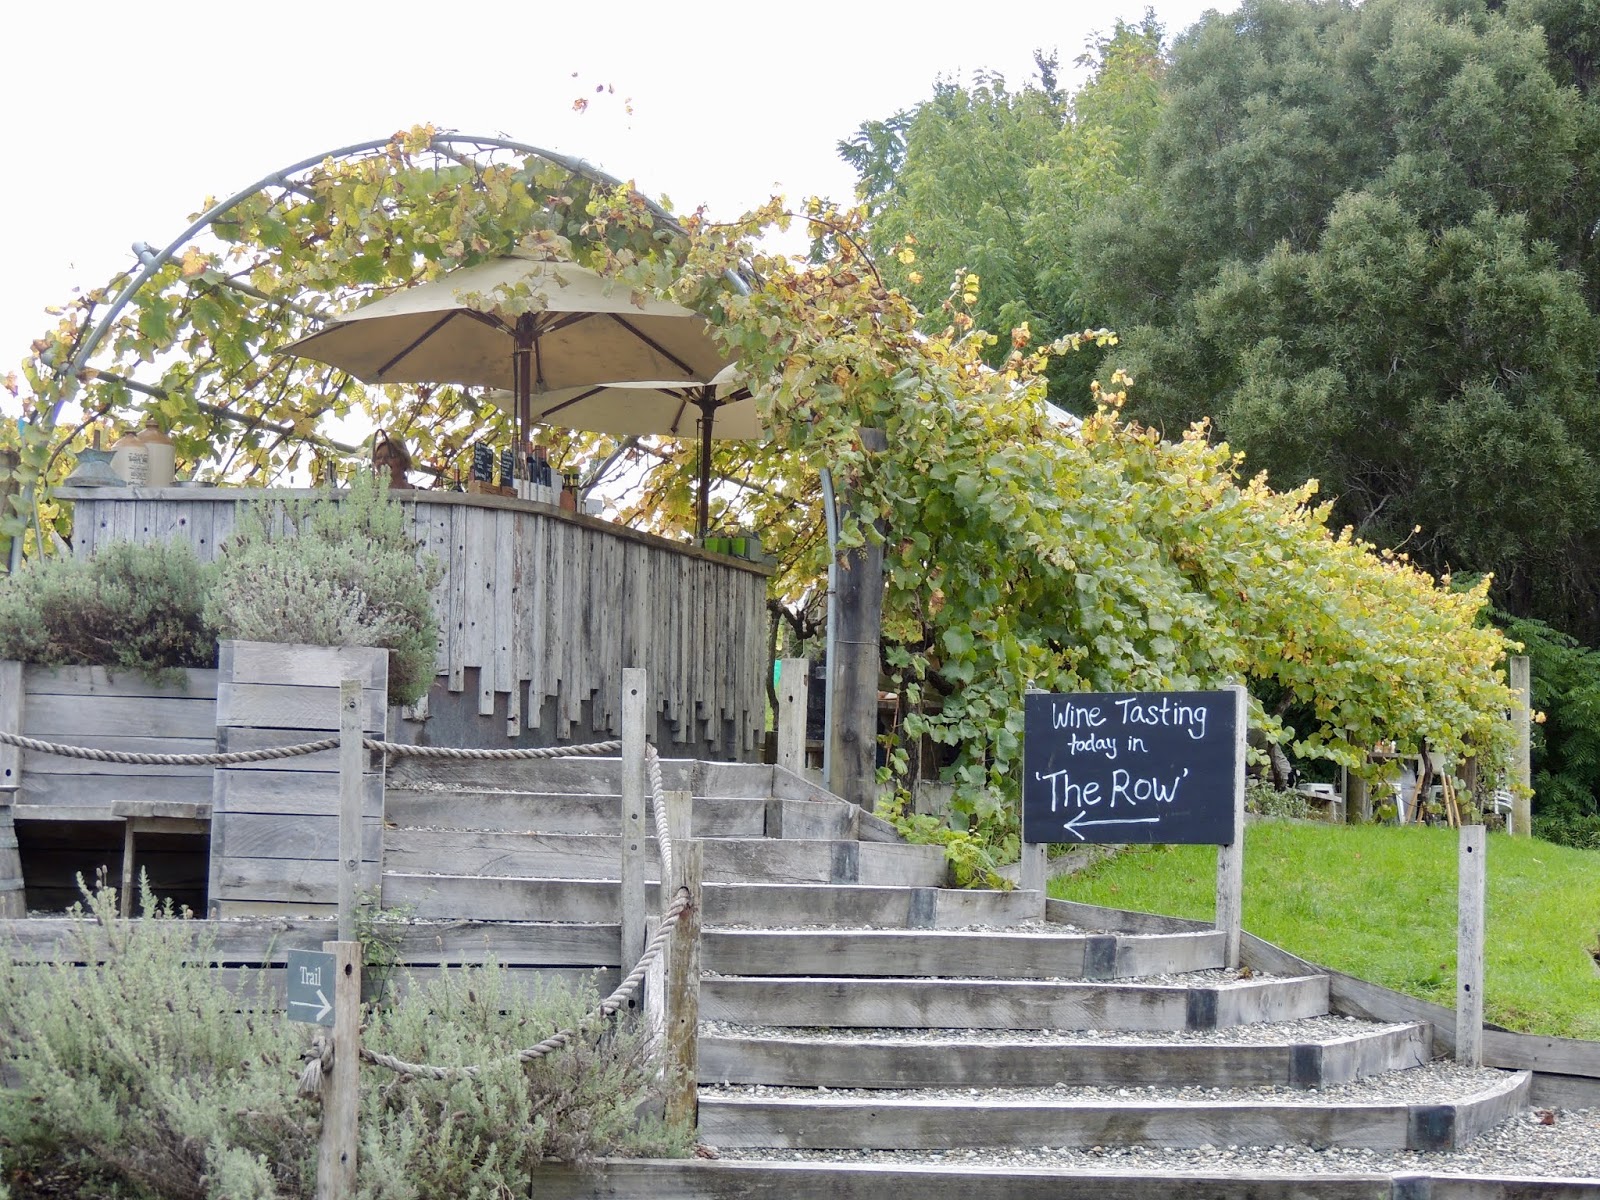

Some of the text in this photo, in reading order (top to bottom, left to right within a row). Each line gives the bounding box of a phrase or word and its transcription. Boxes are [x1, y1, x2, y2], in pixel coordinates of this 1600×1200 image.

[1052, 697, 1207, 739] Wine Tasting
[1067, 733, 1148, 759] today in
[300, 966, 321, 986] Trail
